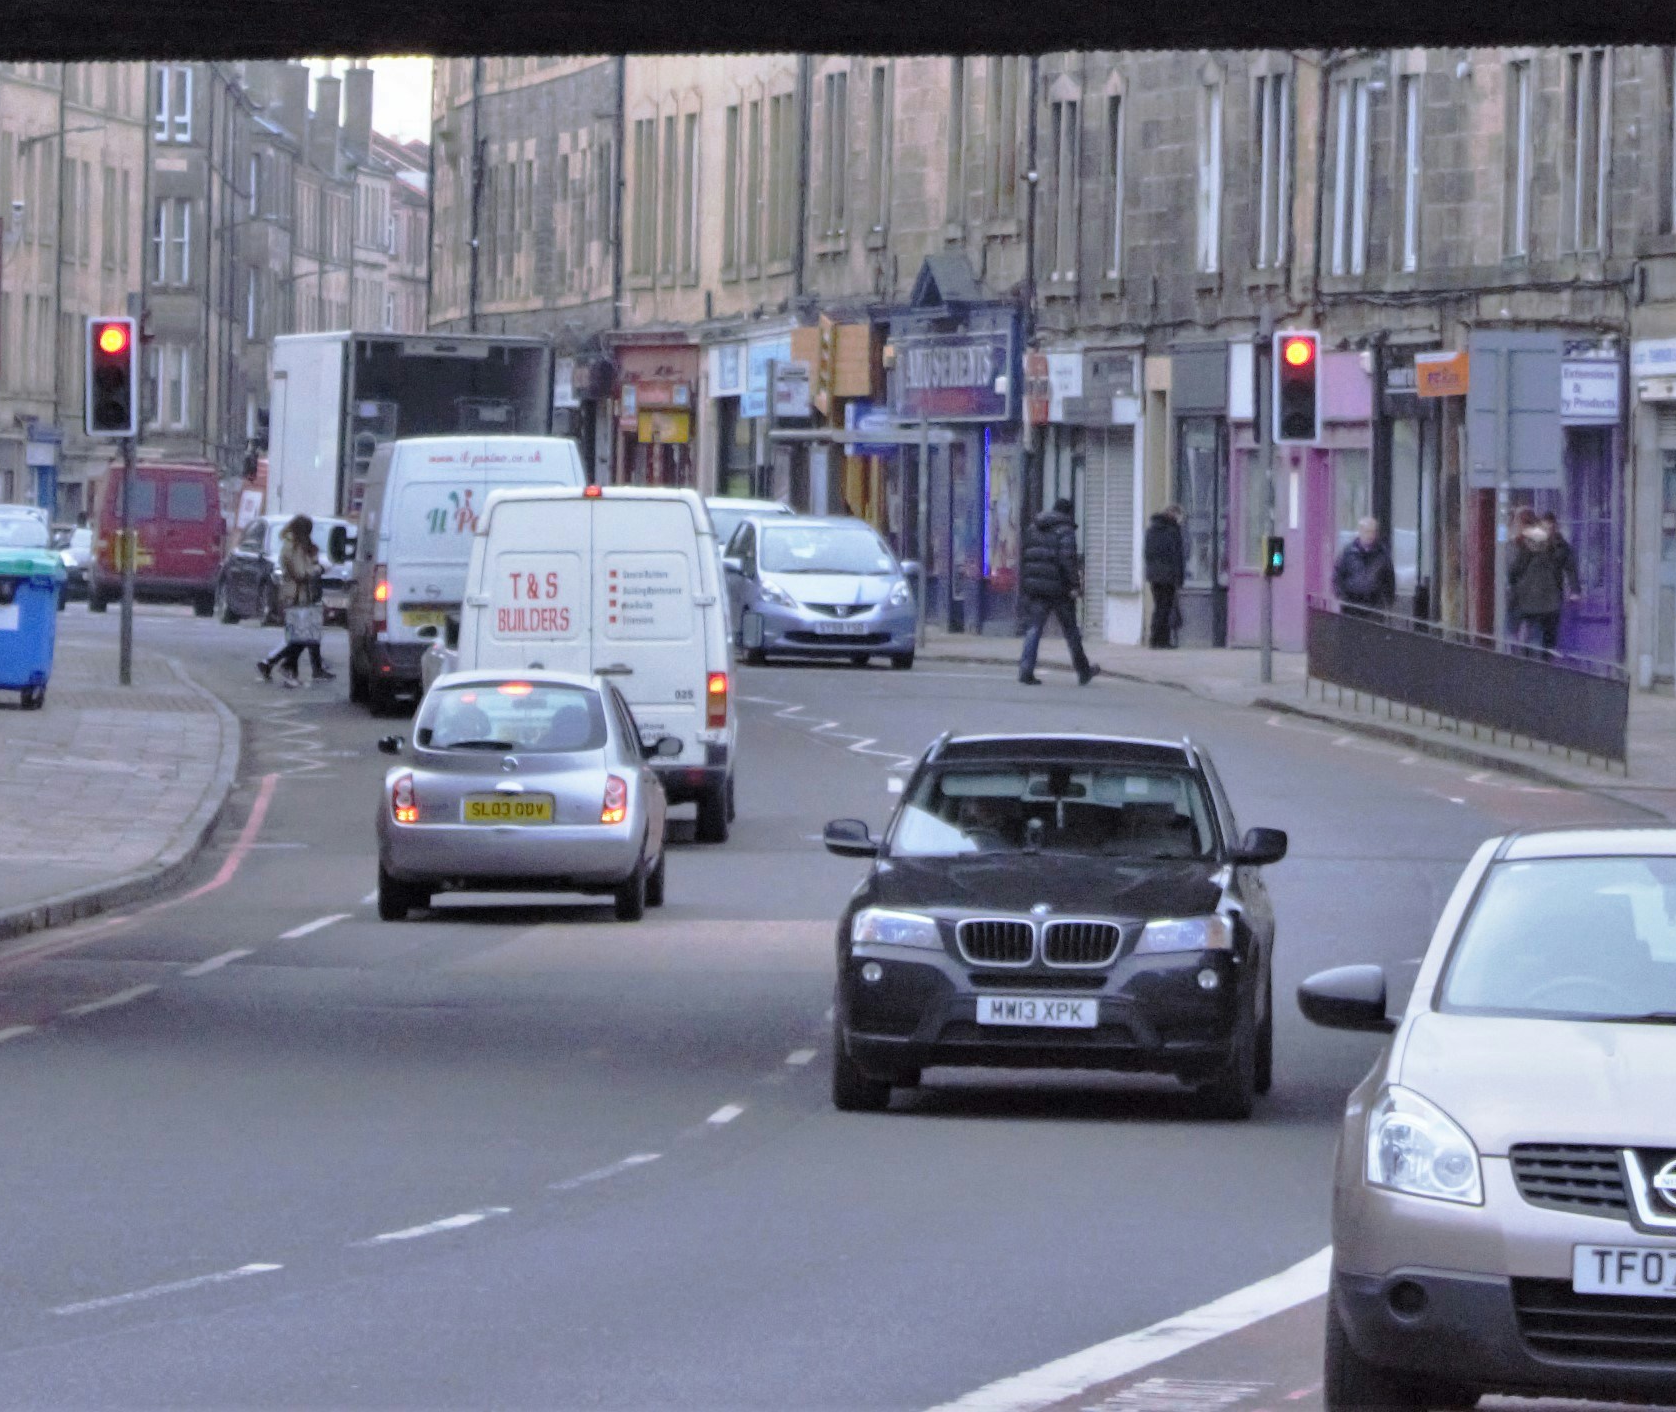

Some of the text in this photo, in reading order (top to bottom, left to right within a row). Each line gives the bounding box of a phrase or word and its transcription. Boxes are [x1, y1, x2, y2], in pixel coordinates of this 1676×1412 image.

[906, 345, 993, 388] AMUSEMENTS
[509, 572, 558, 600] T & S
[498, 608, 570, 632] BUILDERS
[1043, 1001, 1083, 1021] XPK
